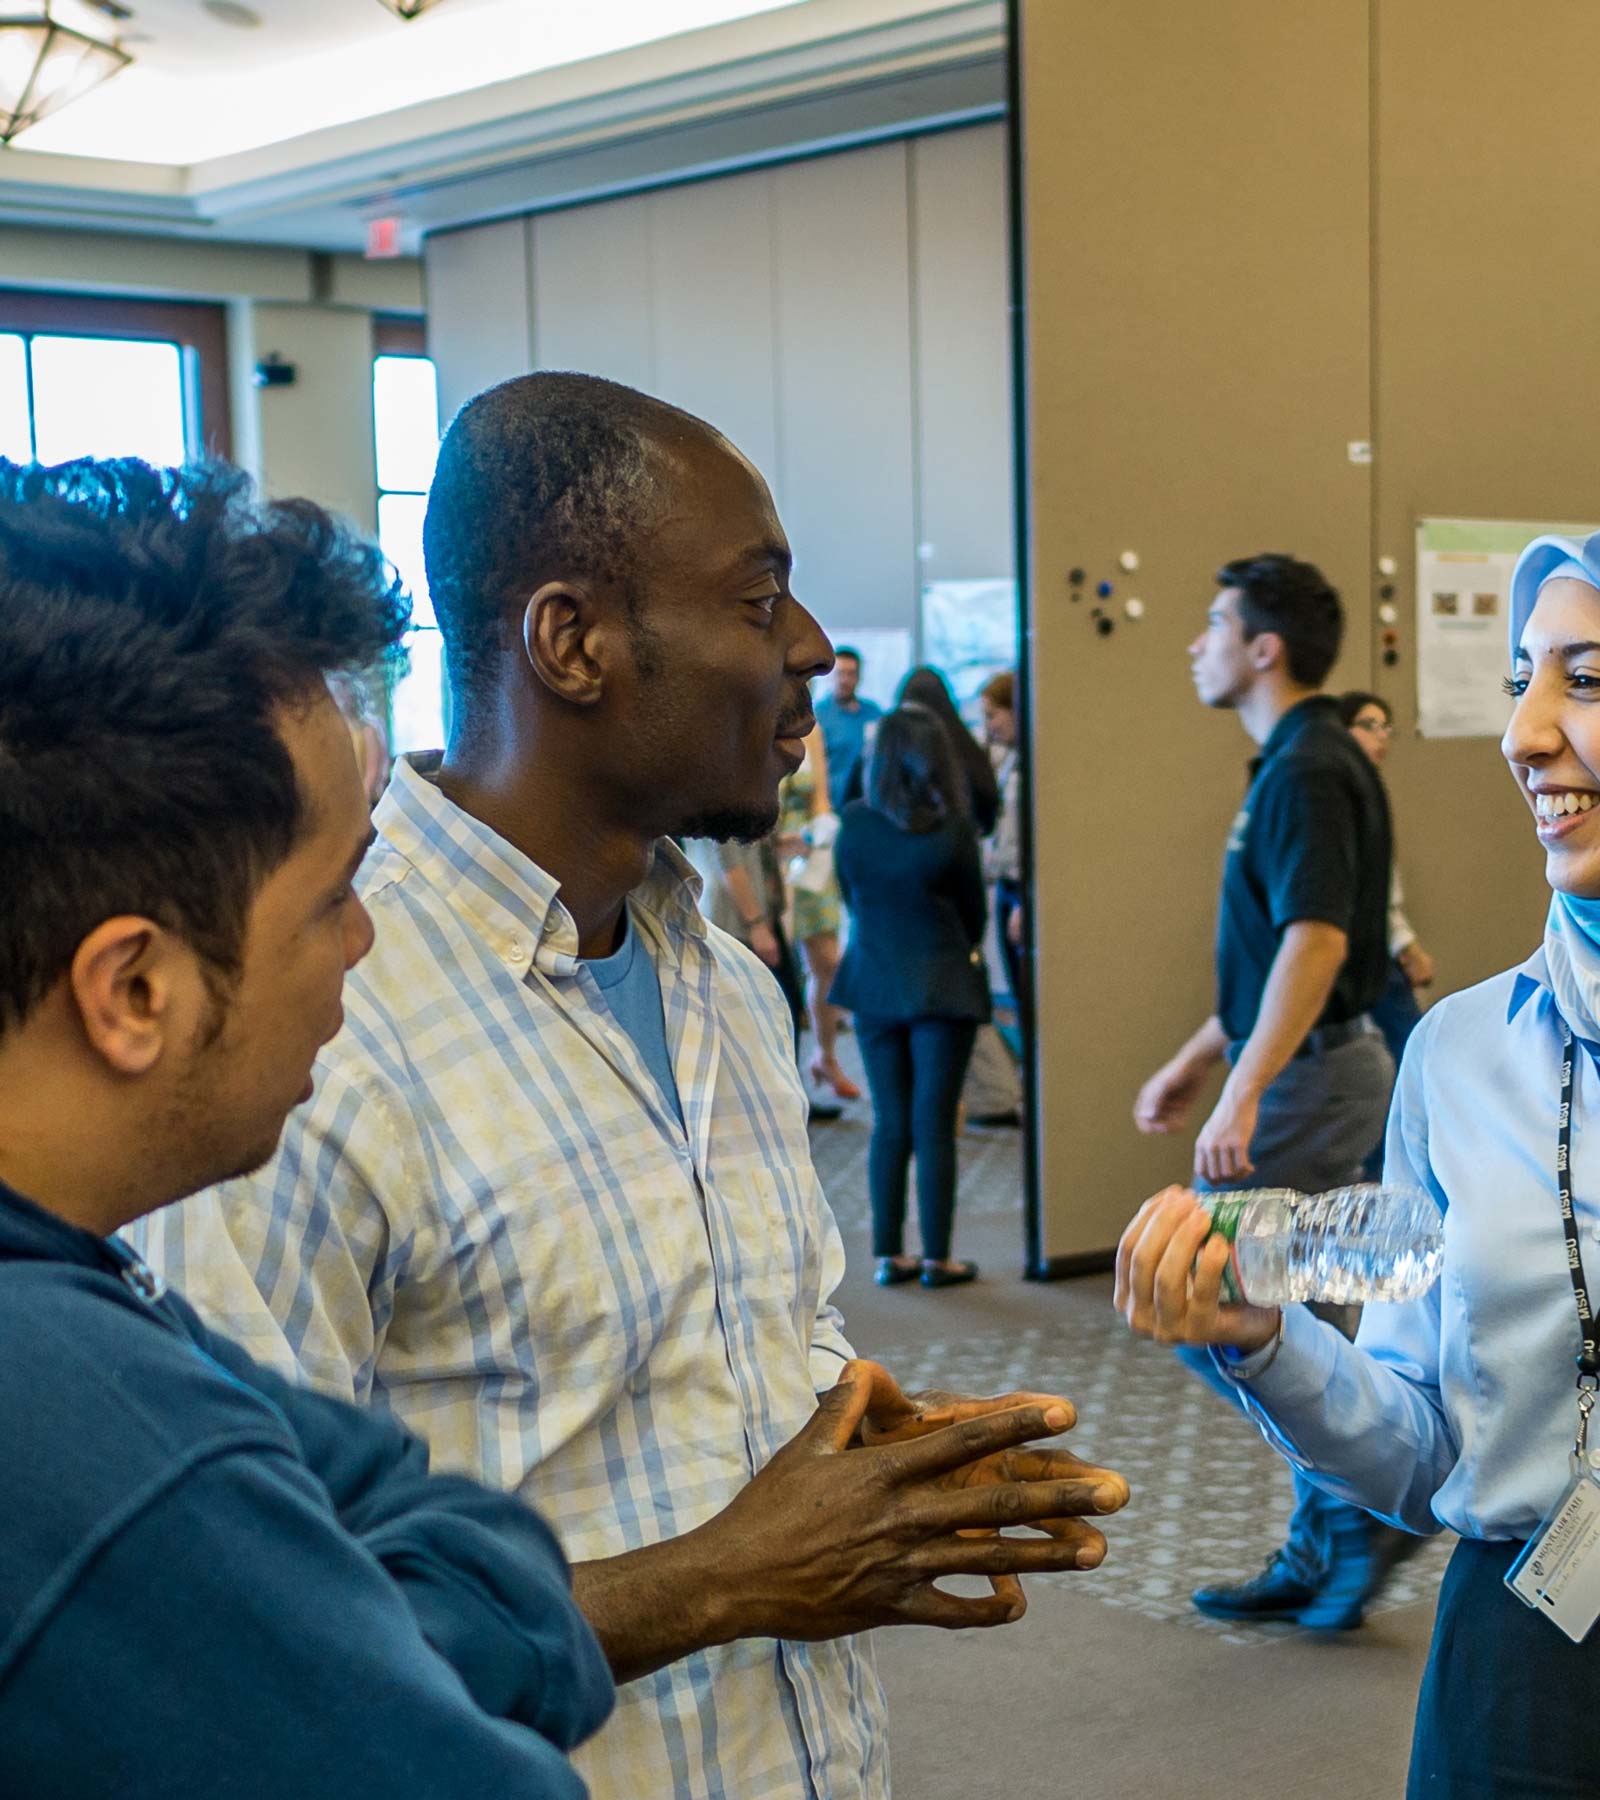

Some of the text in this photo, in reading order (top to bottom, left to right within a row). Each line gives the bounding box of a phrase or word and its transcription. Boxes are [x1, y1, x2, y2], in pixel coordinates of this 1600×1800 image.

[1560, 1061, 1572, 1088] MSU
[1559, 1102, 1570, 1129] MSU
[1557, 1144, 1568, 1172] MSU
[1559, 1189, 1573, 1220] MSU
[1565, 1238, 1580, 1269] MSU
[1574, 1288, 1591, 1320] MSU
[1537, 1516, 1569, 1559] MONTCLAIR
[1565, 1496, 1583, 1517] STATE
